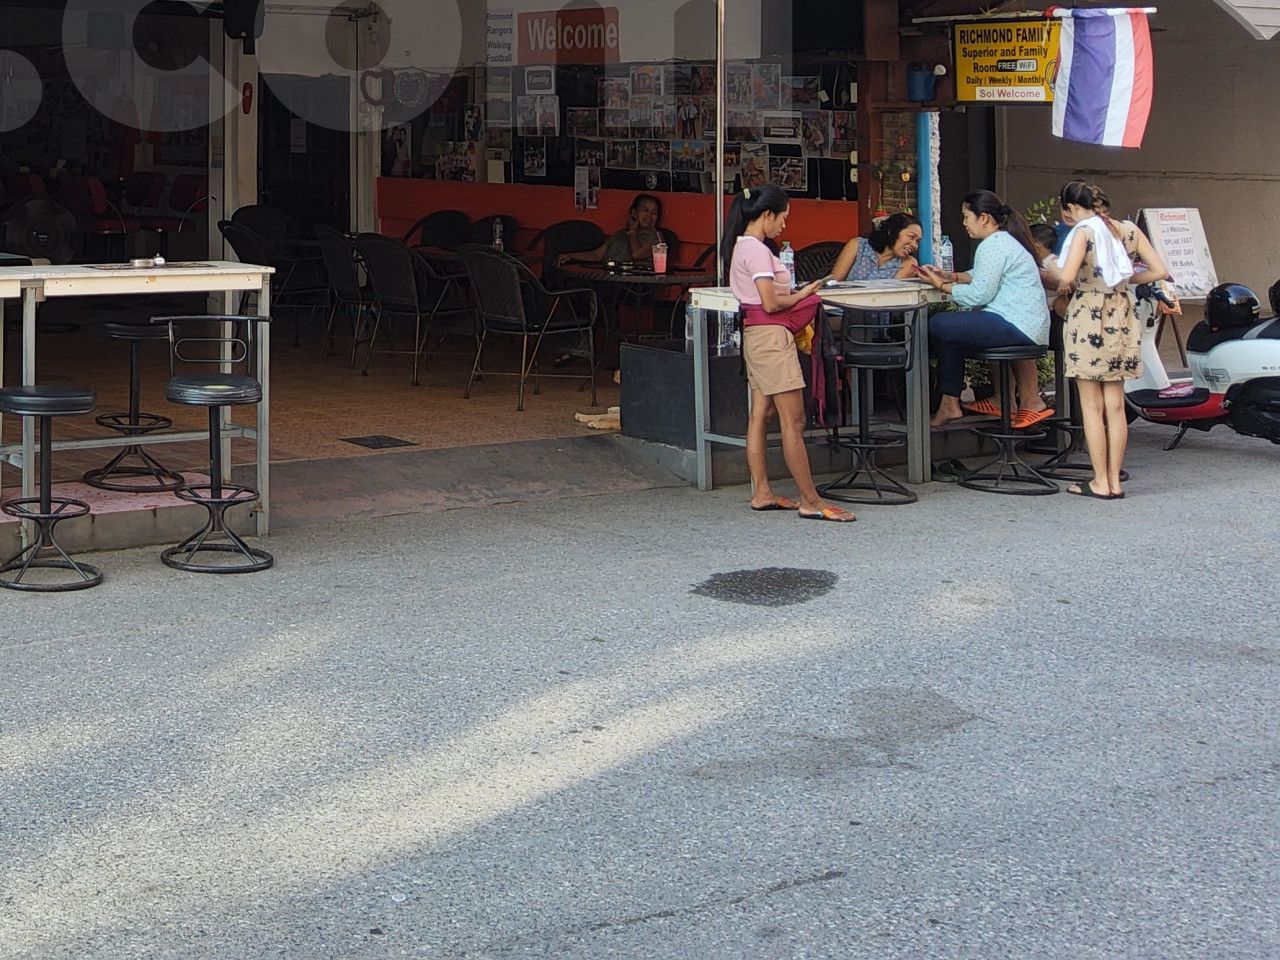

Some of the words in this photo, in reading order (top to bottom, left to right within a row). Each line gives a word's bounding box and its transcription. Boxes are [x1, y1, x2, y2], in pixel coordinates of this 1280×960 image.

[486, 26, 513, 37] Rangers
[527, 17, 619, 51] Welcome
[959, 28, 1013, 45] RICHMOND
[487, 40, 512, 51] Walking
[962, 46, 998, 60] Superior
[1000, 46, 1016, 57] and
[1019, 44, 1049, 58] Family
[486, 53, 512, 63] Football
[973, 62, 998, 73] Room
[998, 62, 1017, 70] FREE
[1019, 61, 1035, 70] WiFi
[966, 76, 983, 86] Daily
[989, 75, 1012, 86] Weekly
[1018, 75, 1045, 85] Monthly
[997, 89, 1041, 99] Welcome
